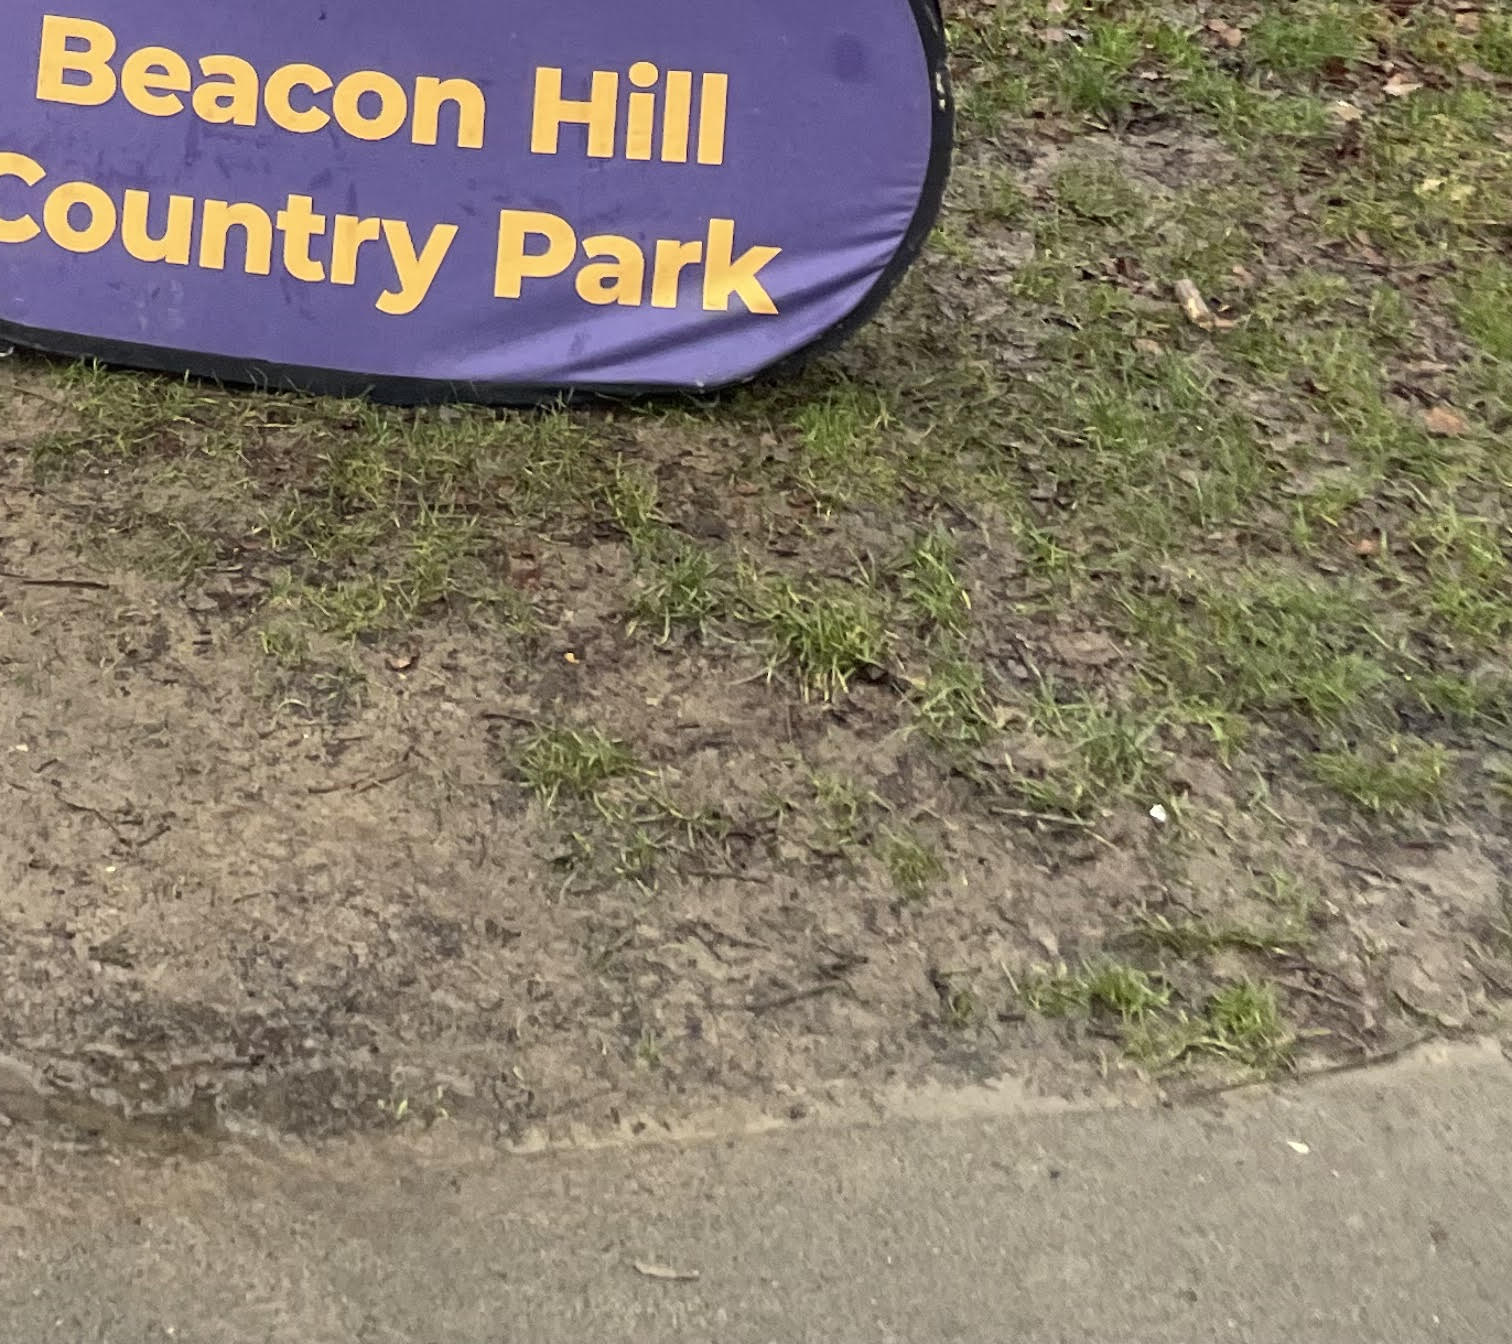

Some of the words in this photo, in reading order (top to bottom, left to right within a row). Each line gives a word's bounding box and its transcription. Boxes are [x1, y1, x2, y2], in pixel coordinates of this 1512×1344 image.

[36, 14, 486, 149] Beacon
[530, 61, 728, 165] Hill
[493, 209, 780, 316] Park
